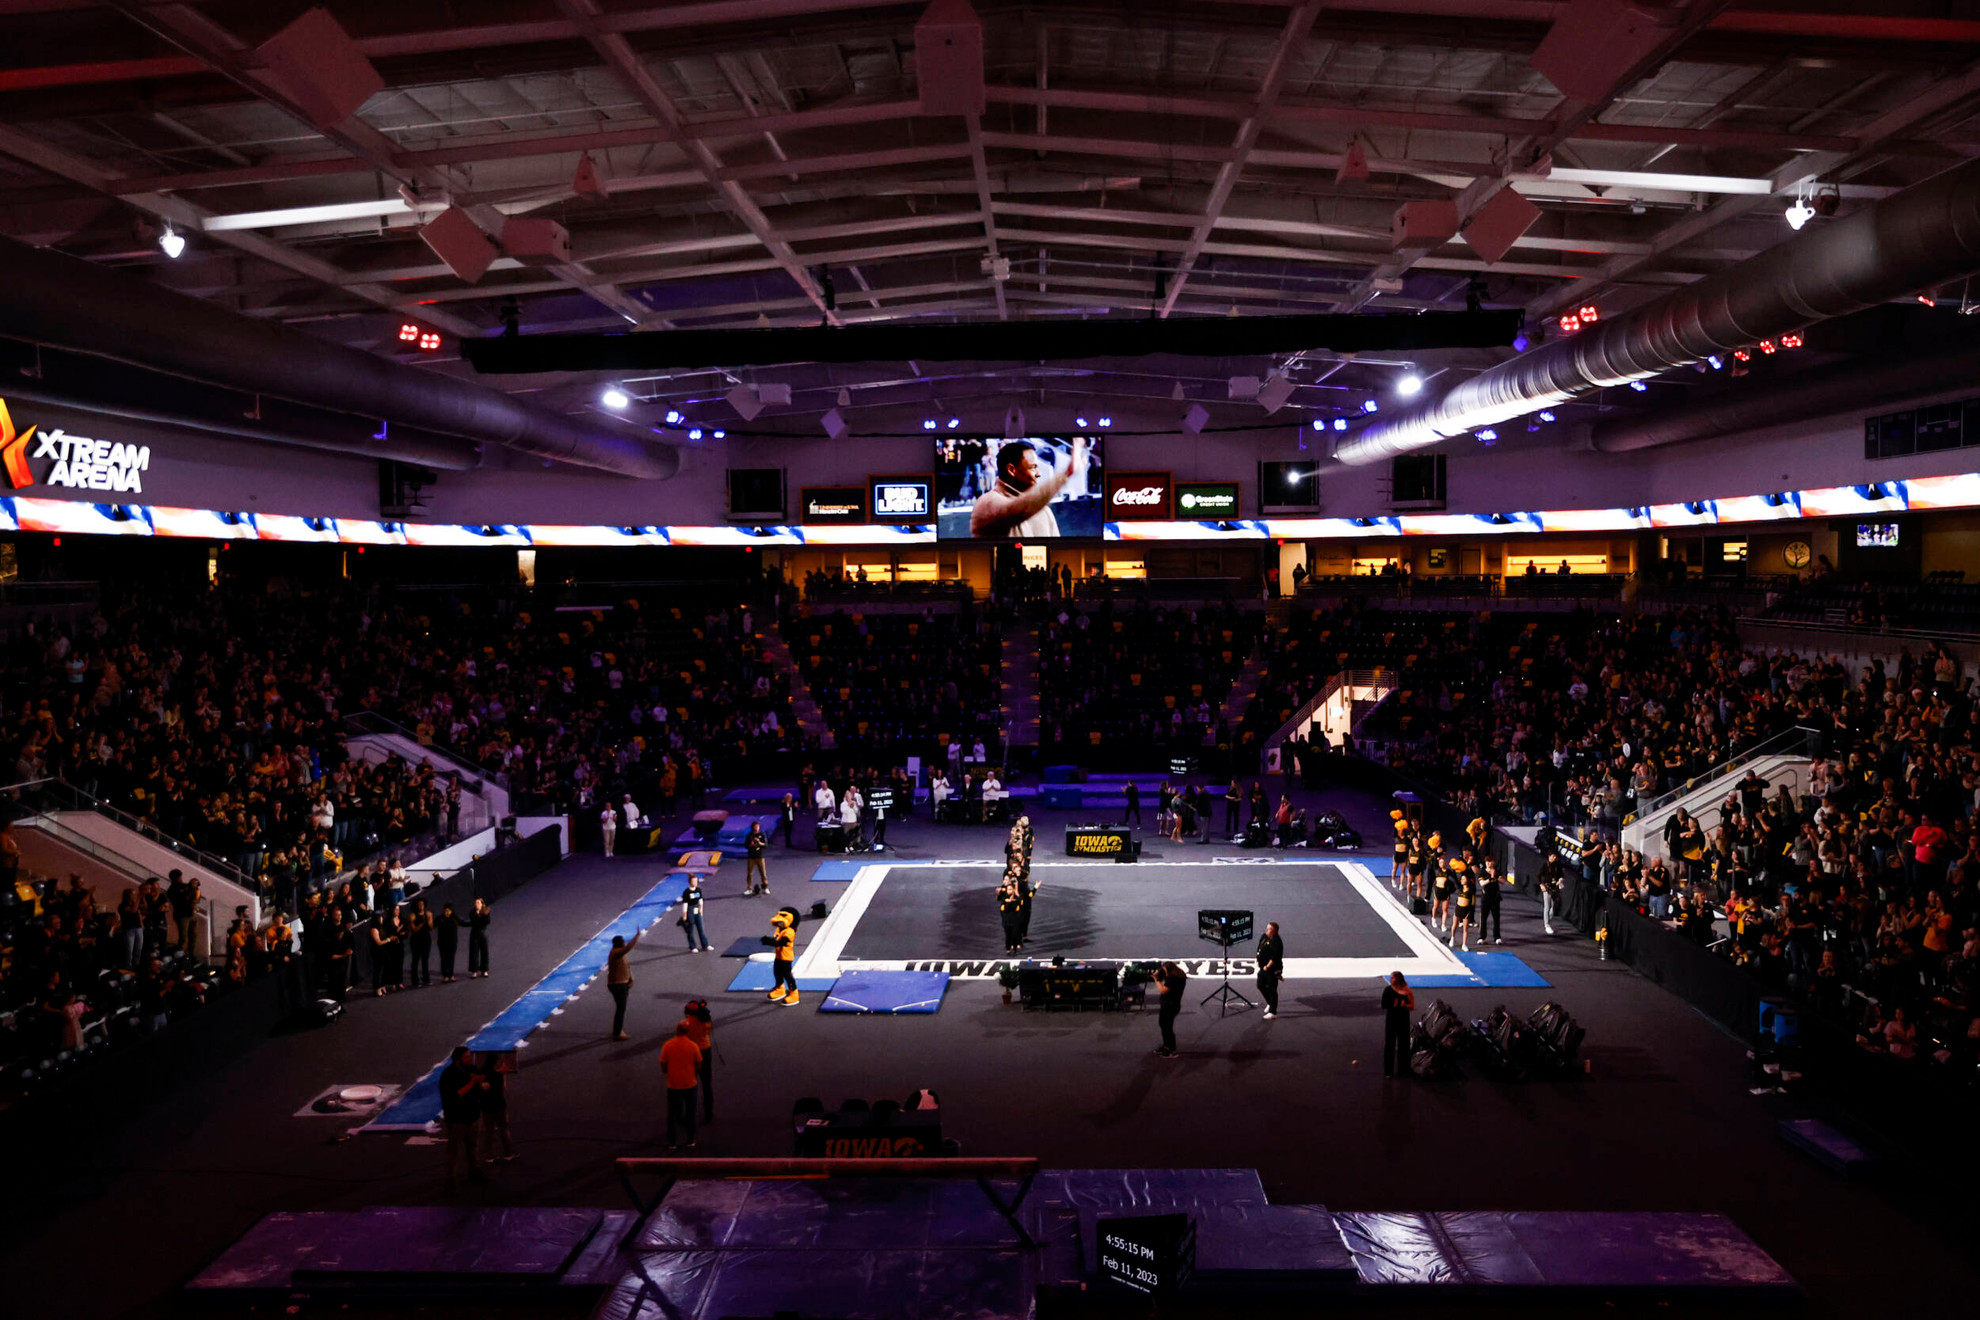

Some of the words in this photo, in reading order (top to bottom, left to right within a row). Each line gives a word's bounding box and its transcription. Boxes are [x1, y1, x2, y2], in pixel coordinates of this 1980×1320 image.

[33, 429, 150, 470] XTREAM
[47, 461, 142, 493] ARENA
[884, 488, 918, 499] BUD
[1113, 487, 1163, 505] Coca-Cola
[1075, 835, 1107, 846] IOWA
[825, 1138, 892, 1158] IOWA
[1106, 1234, 1139, 1255] 4:55:15
[1141, 1246, 1154, 1261] PM
[1103, 1255, 1118, 1270] Feb
[1121, 1262, 1134, 1278] 11,
[1136, 1268, 1158, 1286] 2023
